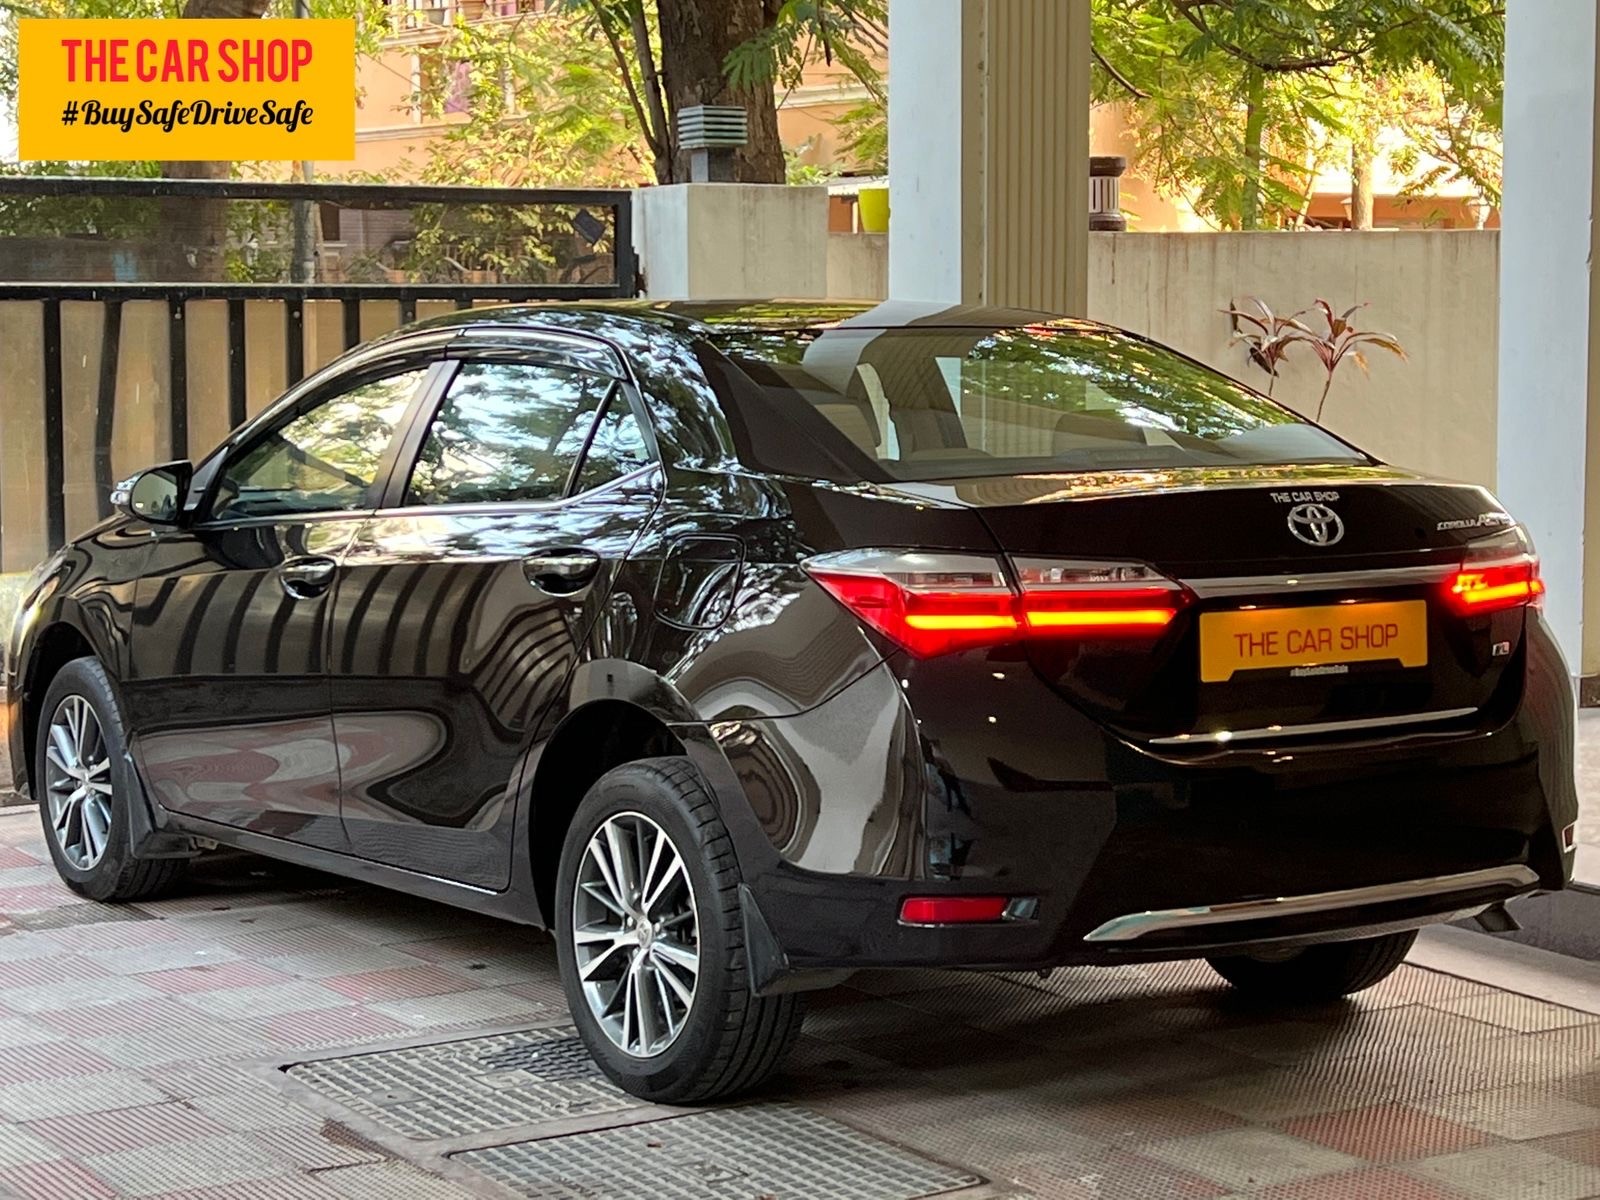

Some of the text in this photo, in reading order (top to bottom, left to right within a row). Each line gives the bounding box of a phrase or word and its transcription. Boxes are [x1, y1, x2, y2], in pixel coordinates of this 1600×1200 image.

[1269, 490, 1340, 503] THE CAR SHOP
[1234, 623, 1399, 658] THE CAR SHOP
